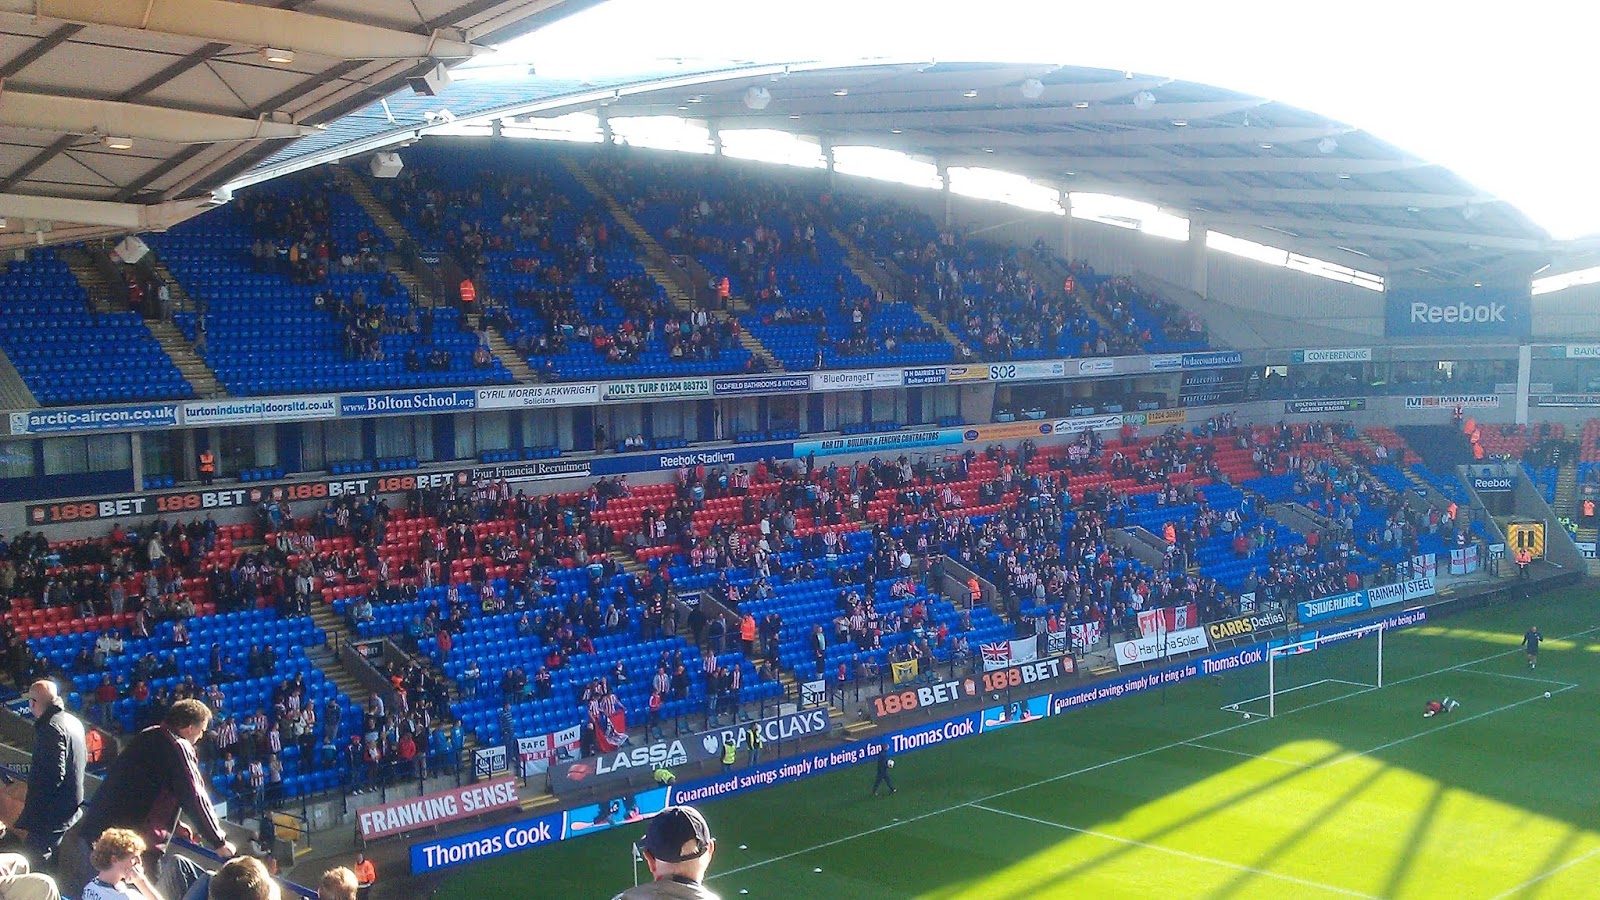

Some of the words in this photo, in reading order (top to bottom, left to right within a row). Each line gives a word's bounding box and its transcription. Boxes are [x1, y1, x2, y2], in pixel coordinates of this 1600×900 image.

[1411, 302, 1507, 323] Reebok
[1308, 351, 1367, 361] CONFERENCING
[479, 389, 506, 401] CYRIL
[508, 387, 543, 399] MORRIS
[544, 385, 597, 397] ARKWRIGHT
[609, 384, 635, 395] HOLTS
[638, 382, 659, 394] TURF
[660, 381, 682, 393] 01204
[716, 382, 744, 392] OLDFIELD
[744, 379, 777, 391] BATHROOMS
[783, 377, 808, 388] KITCHENS
[186, 400, 335, 417] turtonindustrialdoorsltd.co.uk
[523, 396, 556, 405] Solicitors
[30, 406, 174, 426] arctic-aircon.co.uk
[821, 439, 834, 450] AGR
[847, 436, 873, 448] BUILDING
[878, 433, 901, 445] FENCING
[660, 455, 697, 468] Reebok
[698, 452, 736, 466] Stadium
[496, 465, 537, 478] Financial
[538, 461, 592, 474] Recruitment
[1475, 478, 1512, 489] Reebok
[1369, 582, 1408, 602] RAINHAM
[1407, 578, 1433, 594] STEEL
[1311, 594, 1357, 617] SILVERLINE
[1210, 618, 1253, 639] CARRS
[1250, 612, 1284, 631] Pasties
[1176, 635, 1200, 649] Solar
[1202, 655, 1240, 674] Thomas
[1239, 648, 1262, 666] Cook
[1054, 688, 1097, 708] Guaranteed
[1097, 683, 1124, 700] savings
[1124, 676, 1148, 692] simply
[1148, 674, 1160, 687] for
[1185, 665, 1197, 677] fan
[560, 731, 575, 742] IAN
[891, 730, 943, 752] Thomas
[943, 718, 974, 739] Cook
[521, 740, 546, 750] SAFC
[596, 739, 687, 775] LASSA
[650, 756, 687, 771] TYRES
[675, 776, 739, 804] Guaranteed
[740, 770, 778, 788] savings
[779, 759, 812, 780] simply
[813, 756, 829, 770] for
[830, 749, 858, 766] being
[858, 747, 865, 758] a
[867, 743, 882, 757] fan
[360, 794, 459, 836] FRANKING
[460, 780, 519, 813] SENSE
[422, 834, 502, 868] Thomas
[504, 821, 552, 849] Cook
